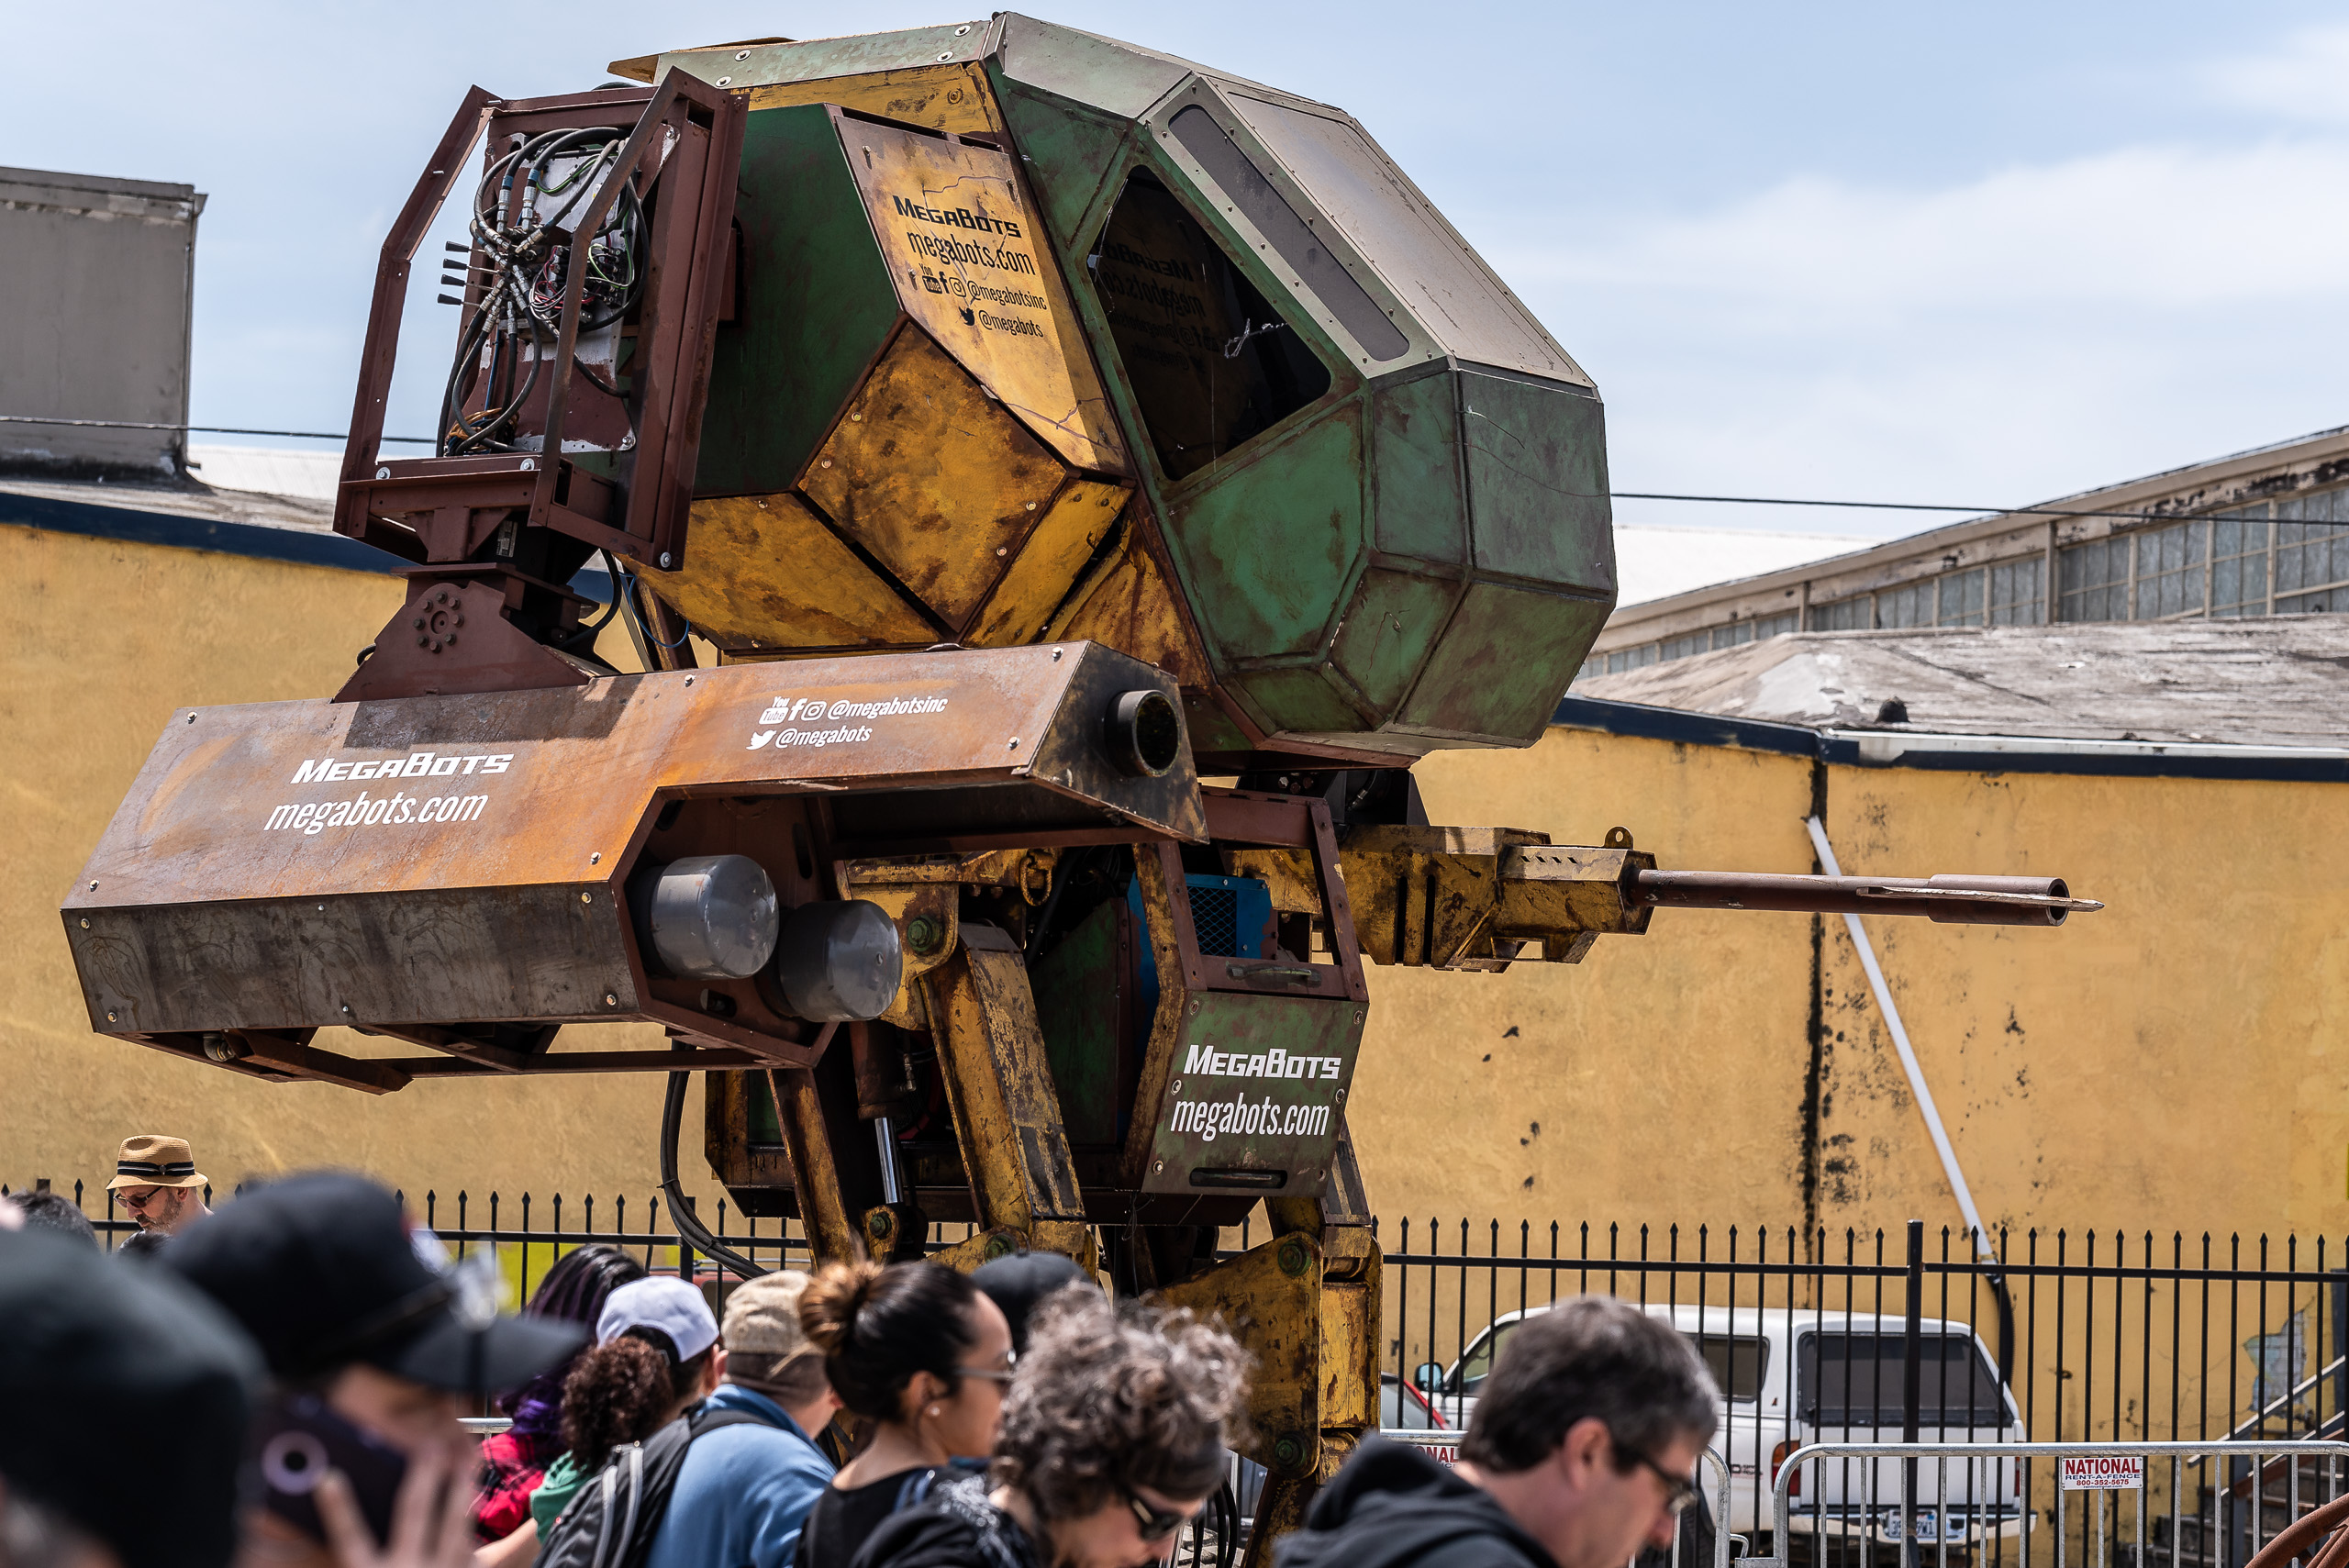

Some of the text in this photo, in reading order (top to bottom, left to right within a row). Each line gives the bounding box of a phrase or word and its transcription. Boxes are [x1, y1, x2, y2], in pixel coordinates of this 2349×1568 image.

[907, 229, 1036, 275] megabots.com
[967, 280, 1048, 311] @megabotsinc
[978, 309, 1044, 339] @megabots
[828, 695, 949, 720] @megabotsinc
[774, 725, 873, 749] @megabots
[263, 790, 489, 836] megabots.com
[1170, 1092, 1330, 1142] megabots.com
[2065, 1458, 2140, 1474] NATIONAL
